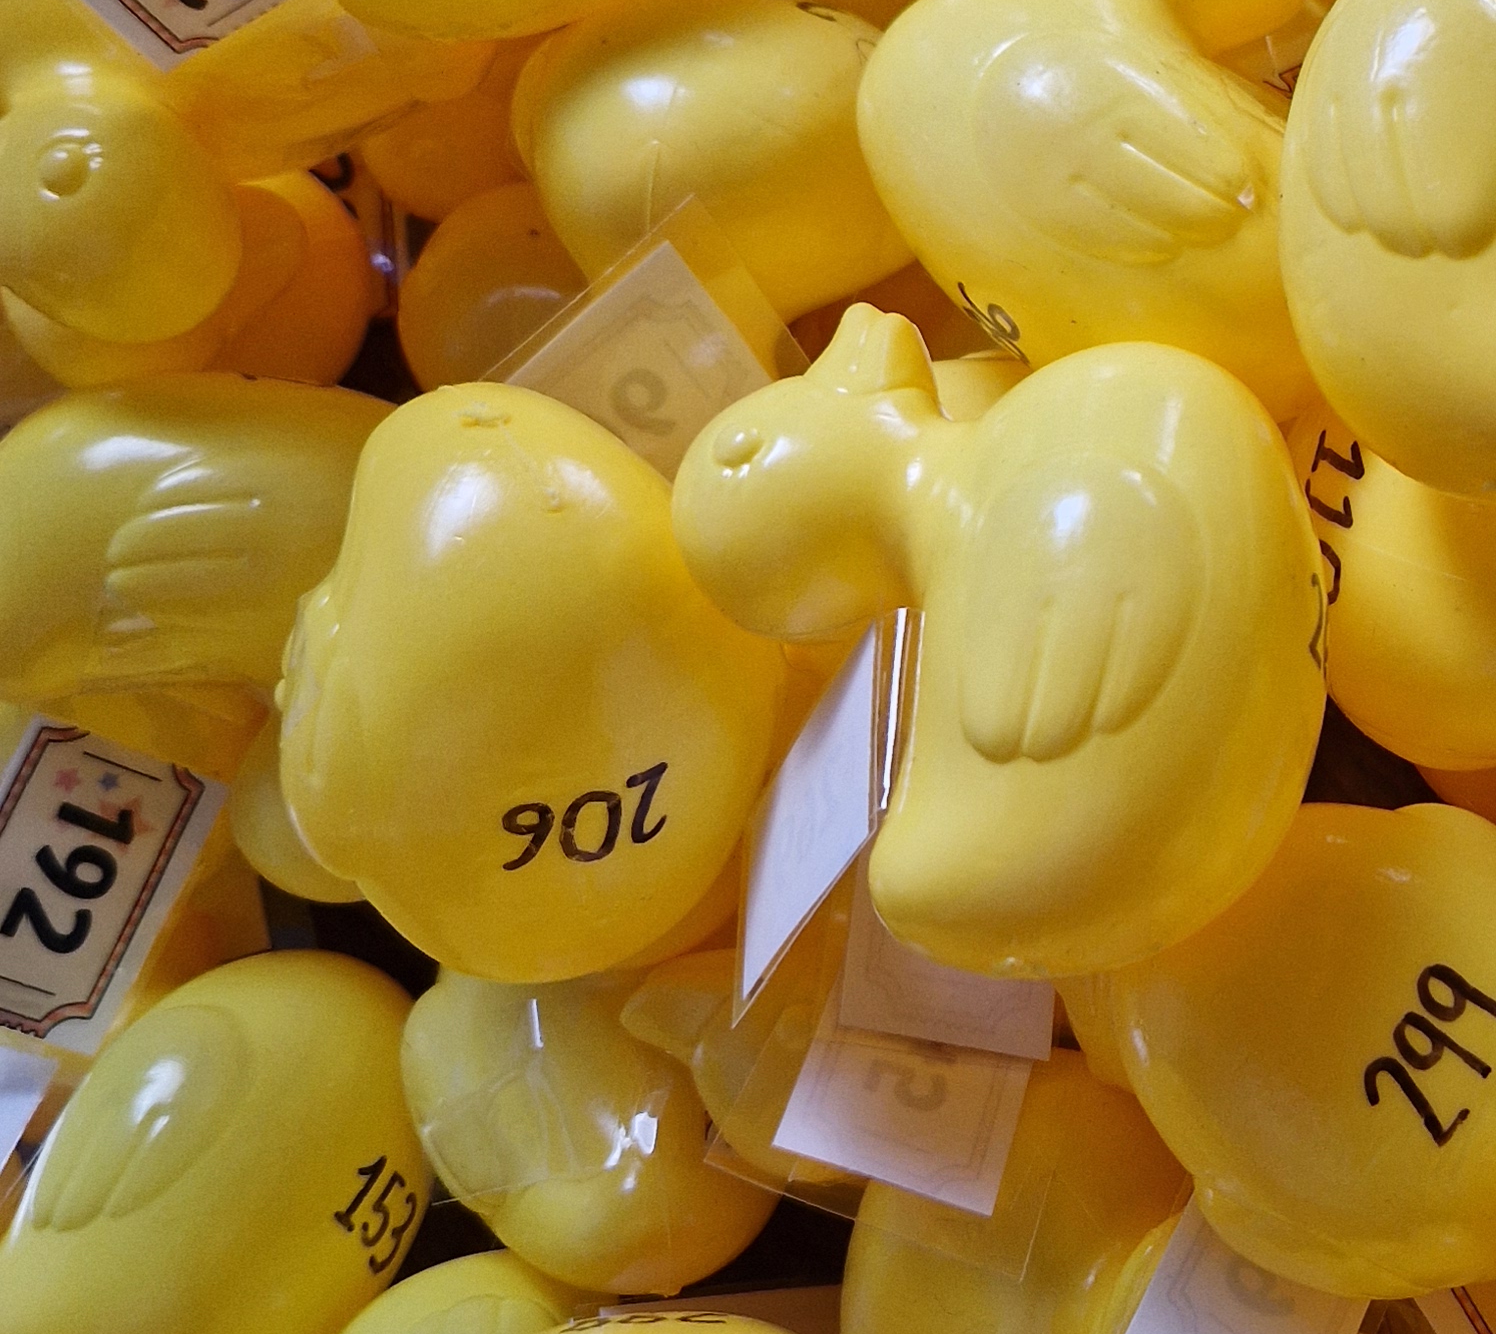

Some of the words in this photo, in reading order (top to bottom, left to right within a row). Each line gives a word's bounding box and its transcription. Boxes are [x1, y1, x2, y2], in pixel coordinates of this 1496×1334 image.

[0, 800, 136, 955] 192
[501, 761, 670, 872] 206
[334, 1153, 418, 1276] 153
